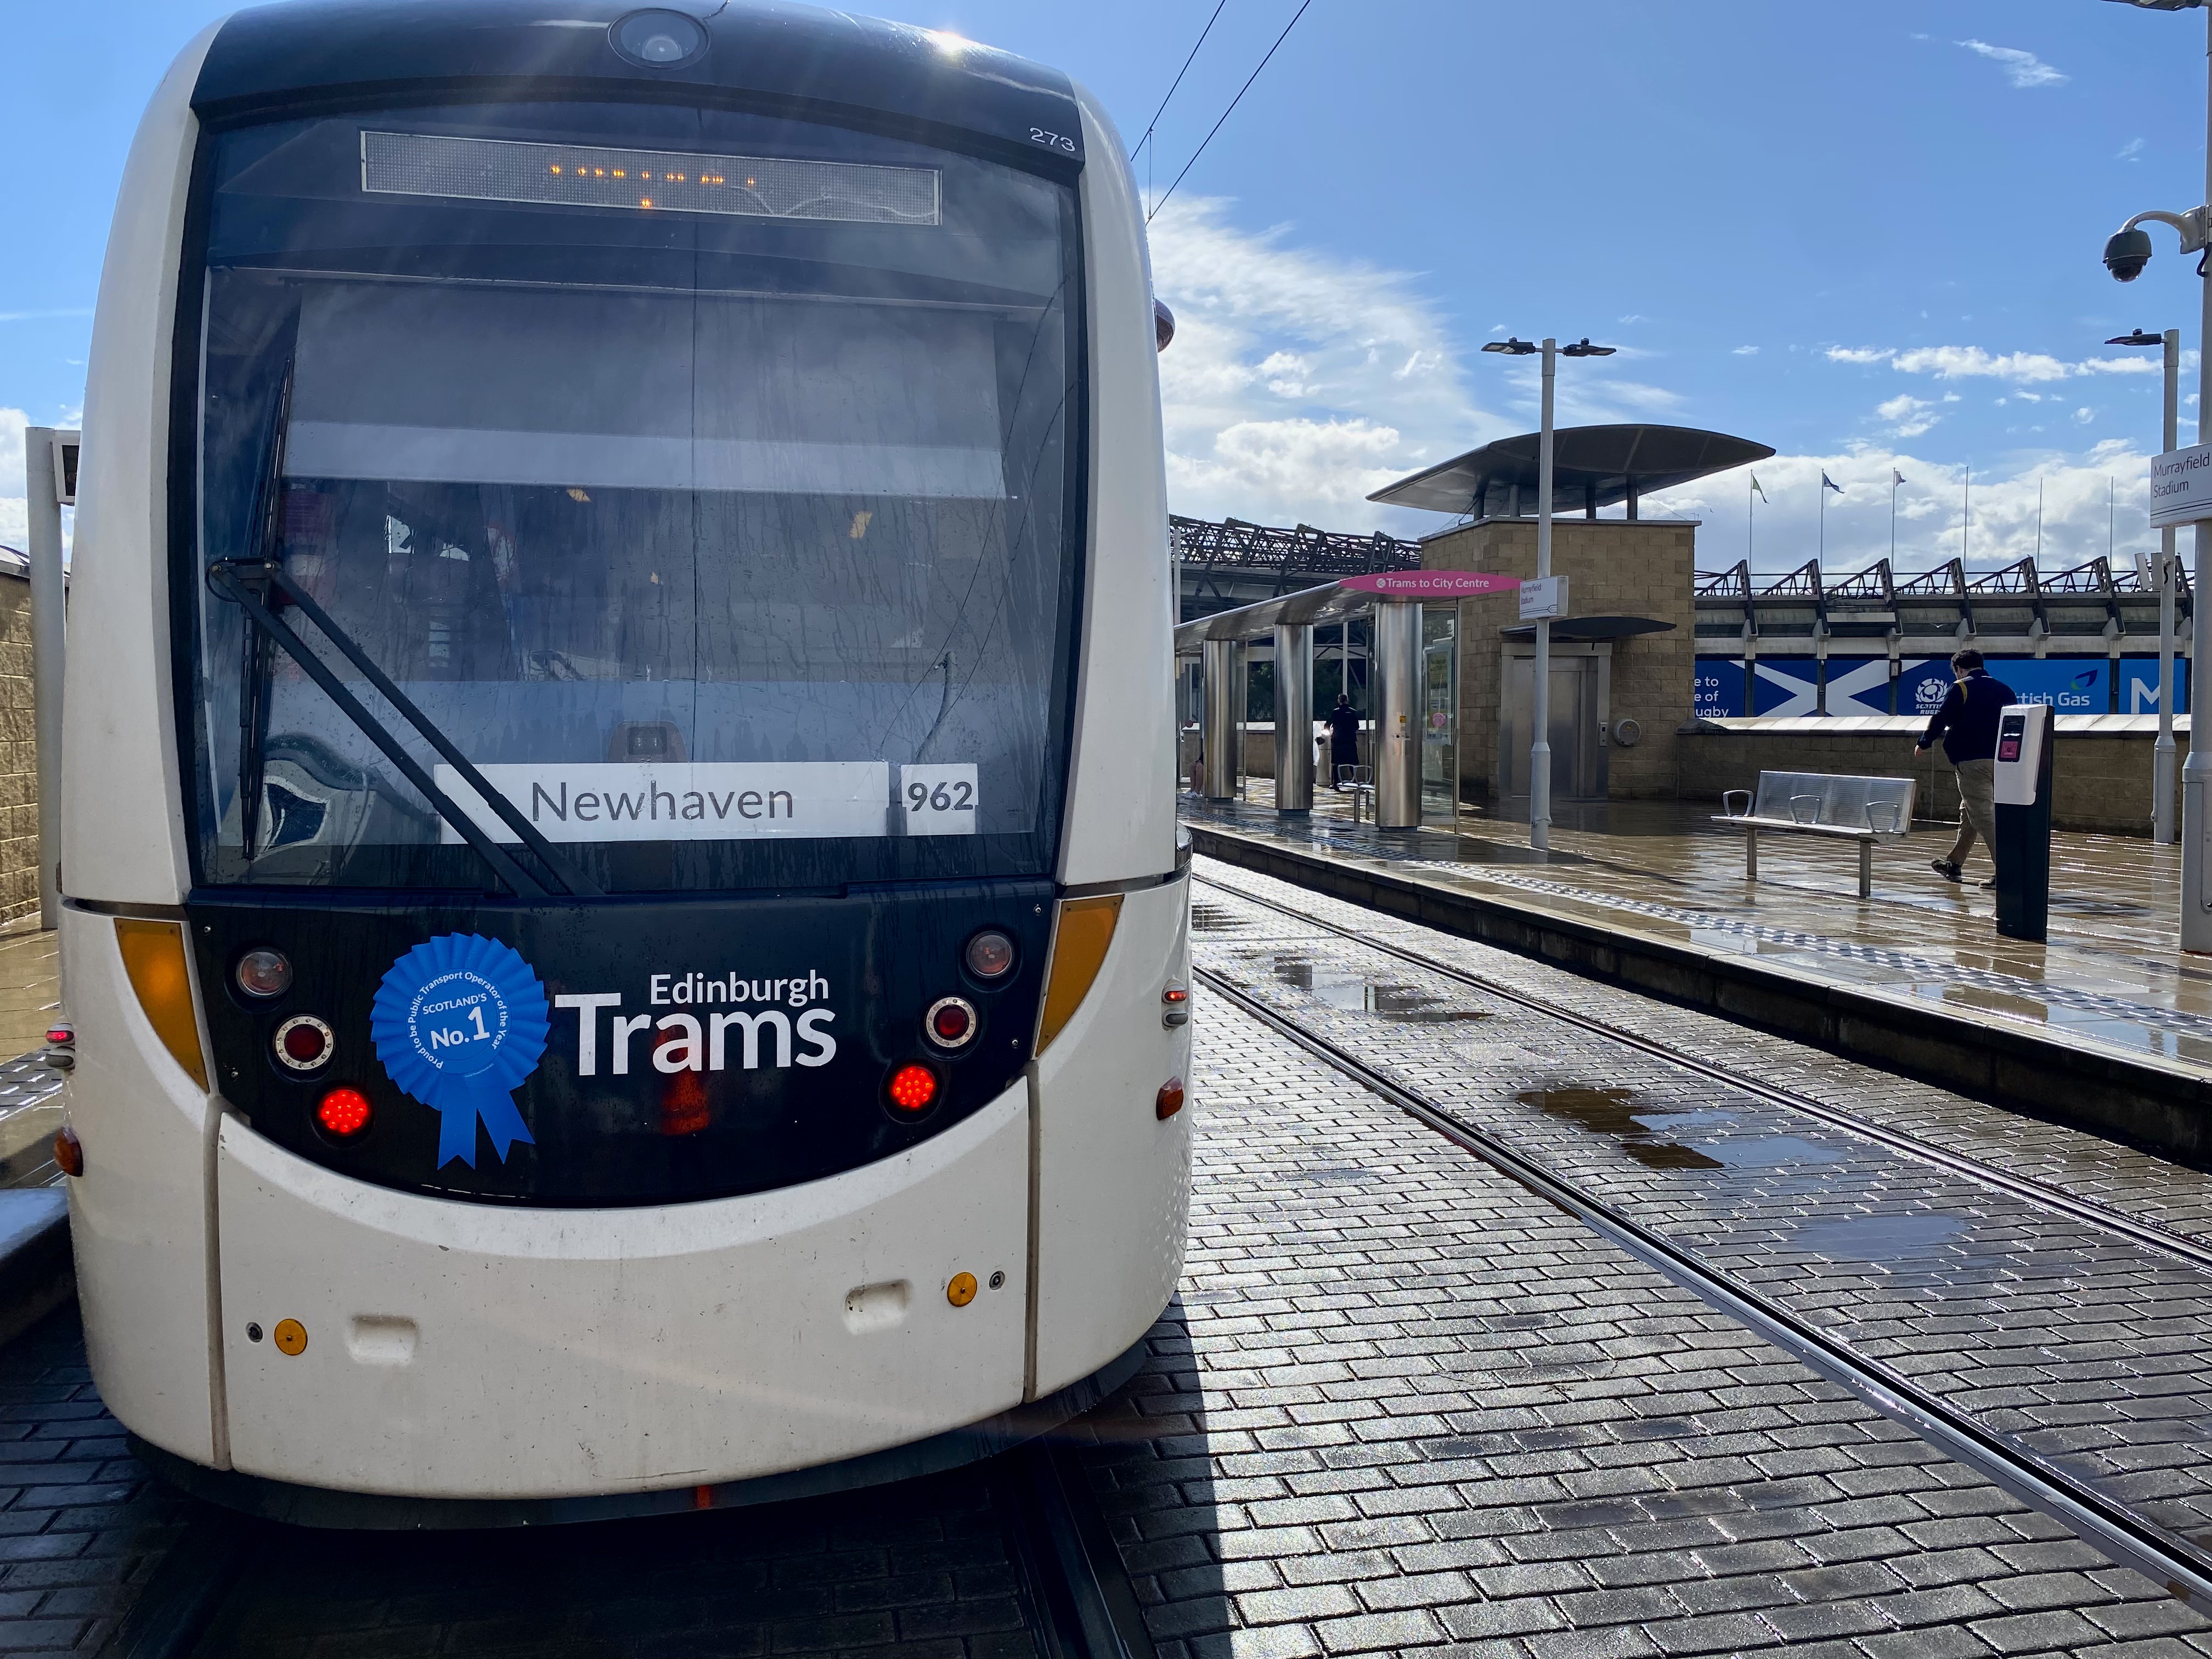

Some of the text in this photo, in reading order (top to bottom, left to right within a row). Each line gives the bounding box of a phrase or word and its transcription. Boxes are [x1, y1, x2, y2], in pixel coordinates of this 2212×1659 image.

[1030, 127, 1075, 152] 273
[2154, 452, 2210, 479] Murrayfield
[2153, 481, 2189, 498] Stadium
[1386, 578, 1489, 590] Trams to City Centre
[1705, 676, 1719, 686] to
[1705, 691, 1719, 702] of
[2058, 692, 2090, 707] Gas
[1695, 706, 1729, 718] ugby
[532, 780, 793, 822] Newhaven
[908, 781, 973, 811] 962
[651, 969, 828, 1007] Edinburgh
[422, 993, 487, 1014] SCOTLAND'S
[408, 971, 508, 1069] Proud to be Public Transport Operator of the Year
[555, 992, 837, 1076] Trams
